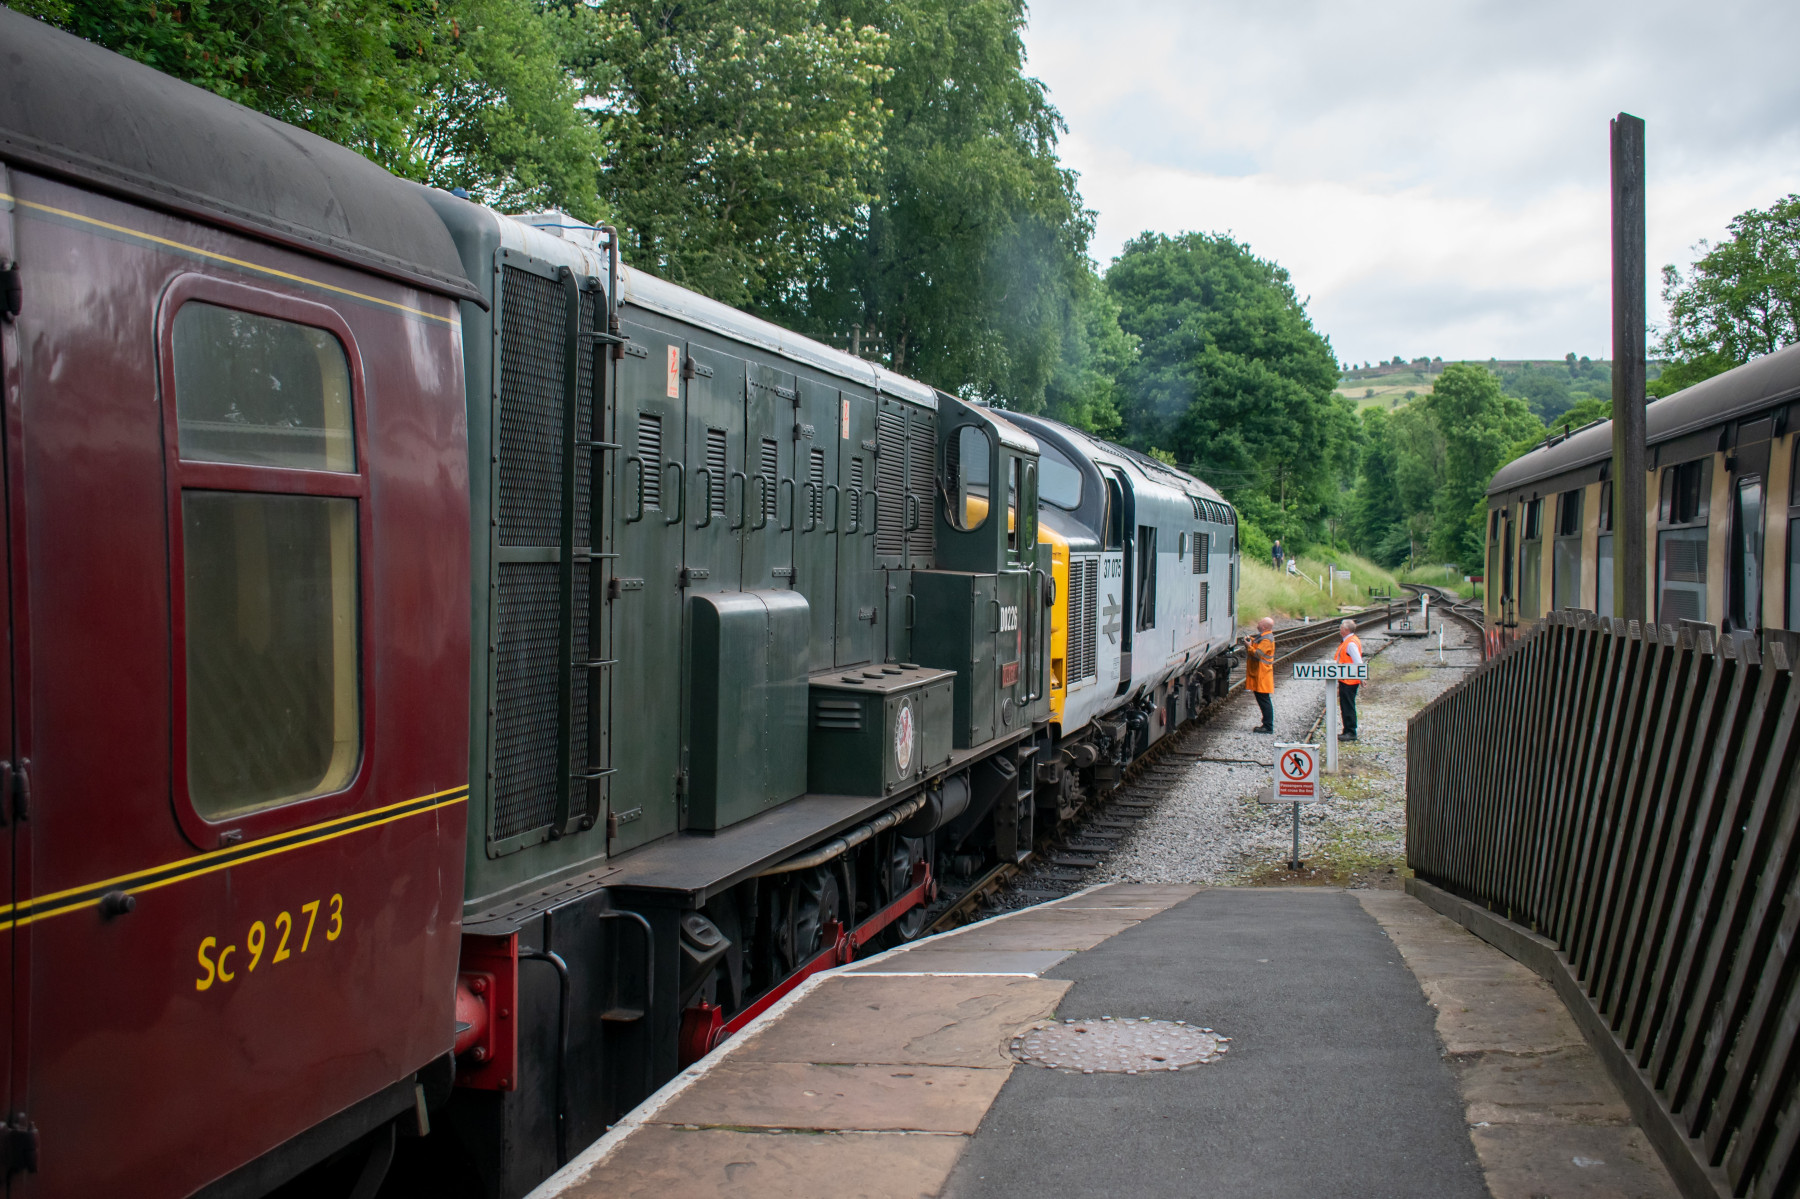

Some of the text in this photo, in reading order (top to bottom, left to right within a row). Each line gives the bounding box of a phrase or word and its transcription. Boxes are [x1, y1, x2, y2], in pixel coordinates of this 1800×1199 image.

[1103, 558, 1121, 579] 37 075
[1296, 665, 1366, 678] WHISTLE
[196, 893, 343, 991] Sc 9273
